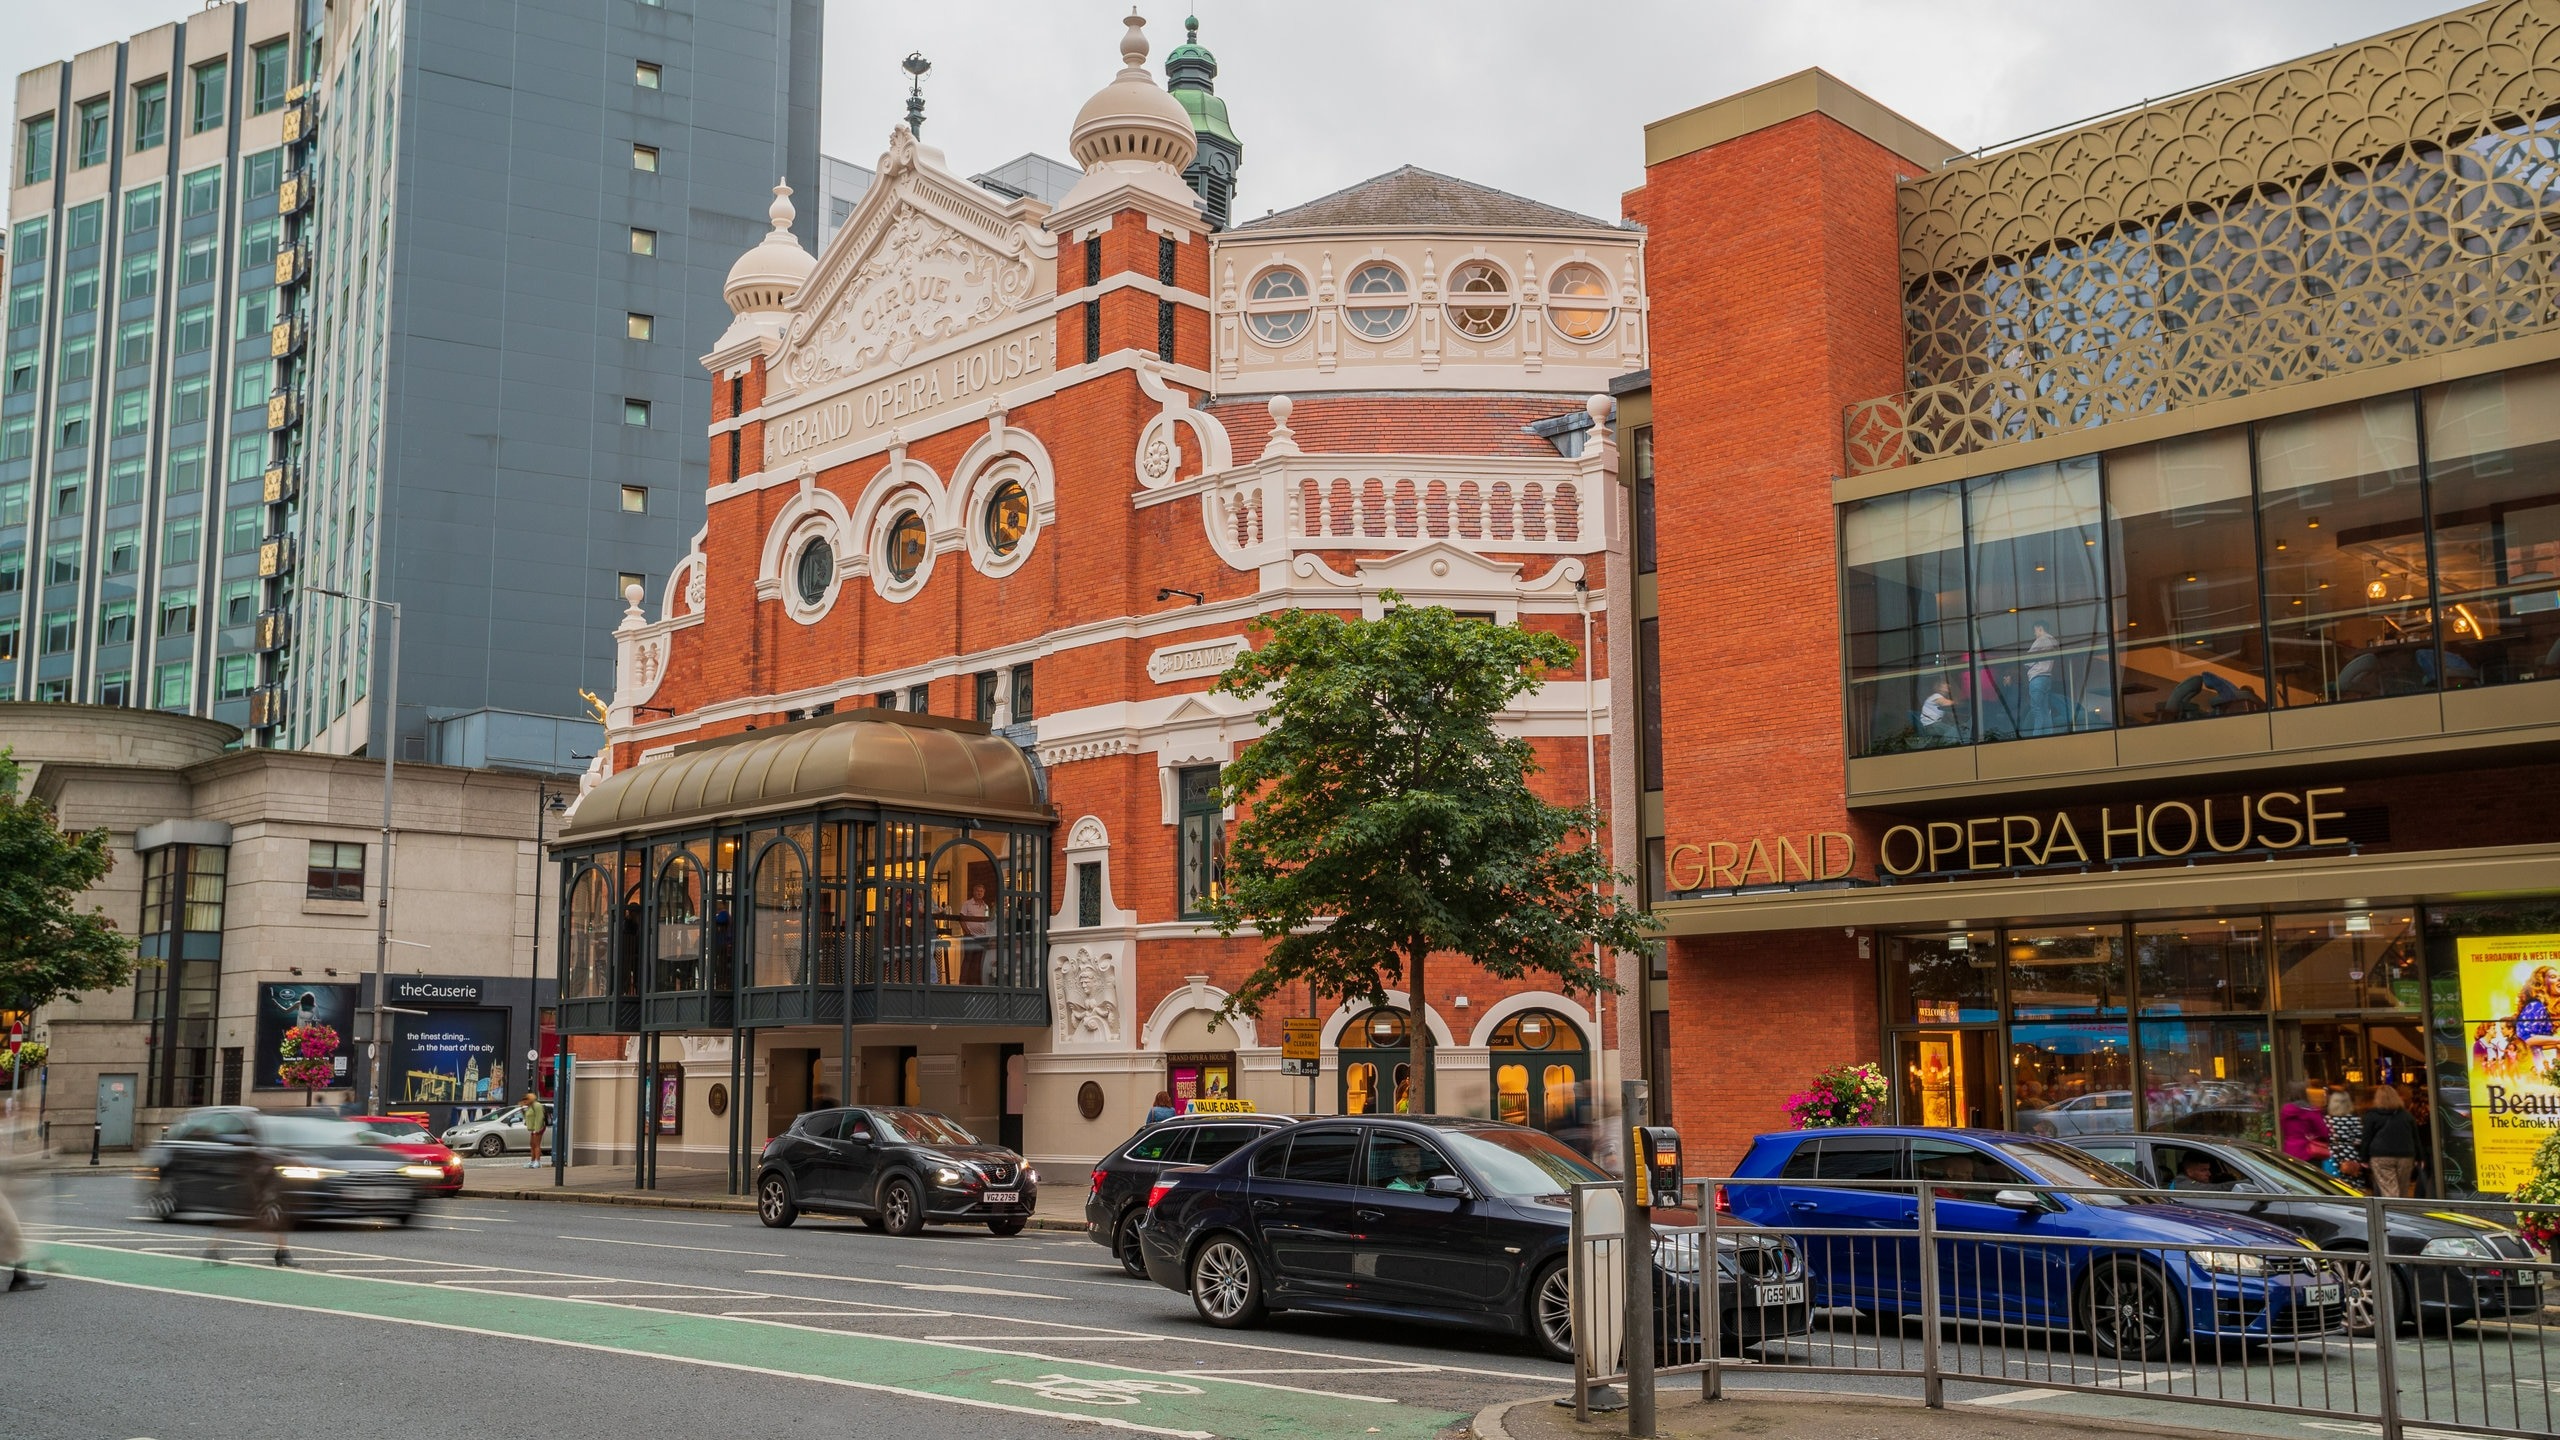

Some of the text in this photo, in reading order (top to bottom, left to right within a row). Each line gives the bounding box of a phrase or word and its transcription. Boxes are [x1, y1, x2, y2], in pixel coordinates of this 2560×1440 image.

[861, 275, 951, 331] CIRQUE
[778, 331, 1043, 457] GRAND OPERA HOUSE
[1173, 647, 1226, 672] DRAMA
[1668, 787, 2349, 891] GRAND OPERA HOUSE
[2471, 951, 2560, 962] THE BROADWAY & WEST EN
[400, 982, 477, 998] theCauserie
[1919, 1007, 1947, 1017] WELCOME
[407, 1032, 470, 1042] the finest dining...
[426, 1044, 438, 1052] the
[440, 1044, 459, 1052] heart
[460, 1044, 468, 1052] of
[468, 1044, 480, 1052] the
[481, 1044, 495, 1053] city
[1176, 1081, 1197, 1091] BRIDES
[1177, 1090, 1197, 1099] MAIDS
[2486, 1085, 2560, 1115] Beau
[1195, 1101, 1219, 1113] VALUE
[1220, 1101, 1240, 1113] CABS
[2489, 1116, 2509, 1128] The
[2511, 1116, 2547, 1128] Carole
[1657, 1153, 1675, 1165] WAIT
[2512, 1167, 2525, 1176] Tue
[1760, 1285, 1802, 1303] YG59 MLN
